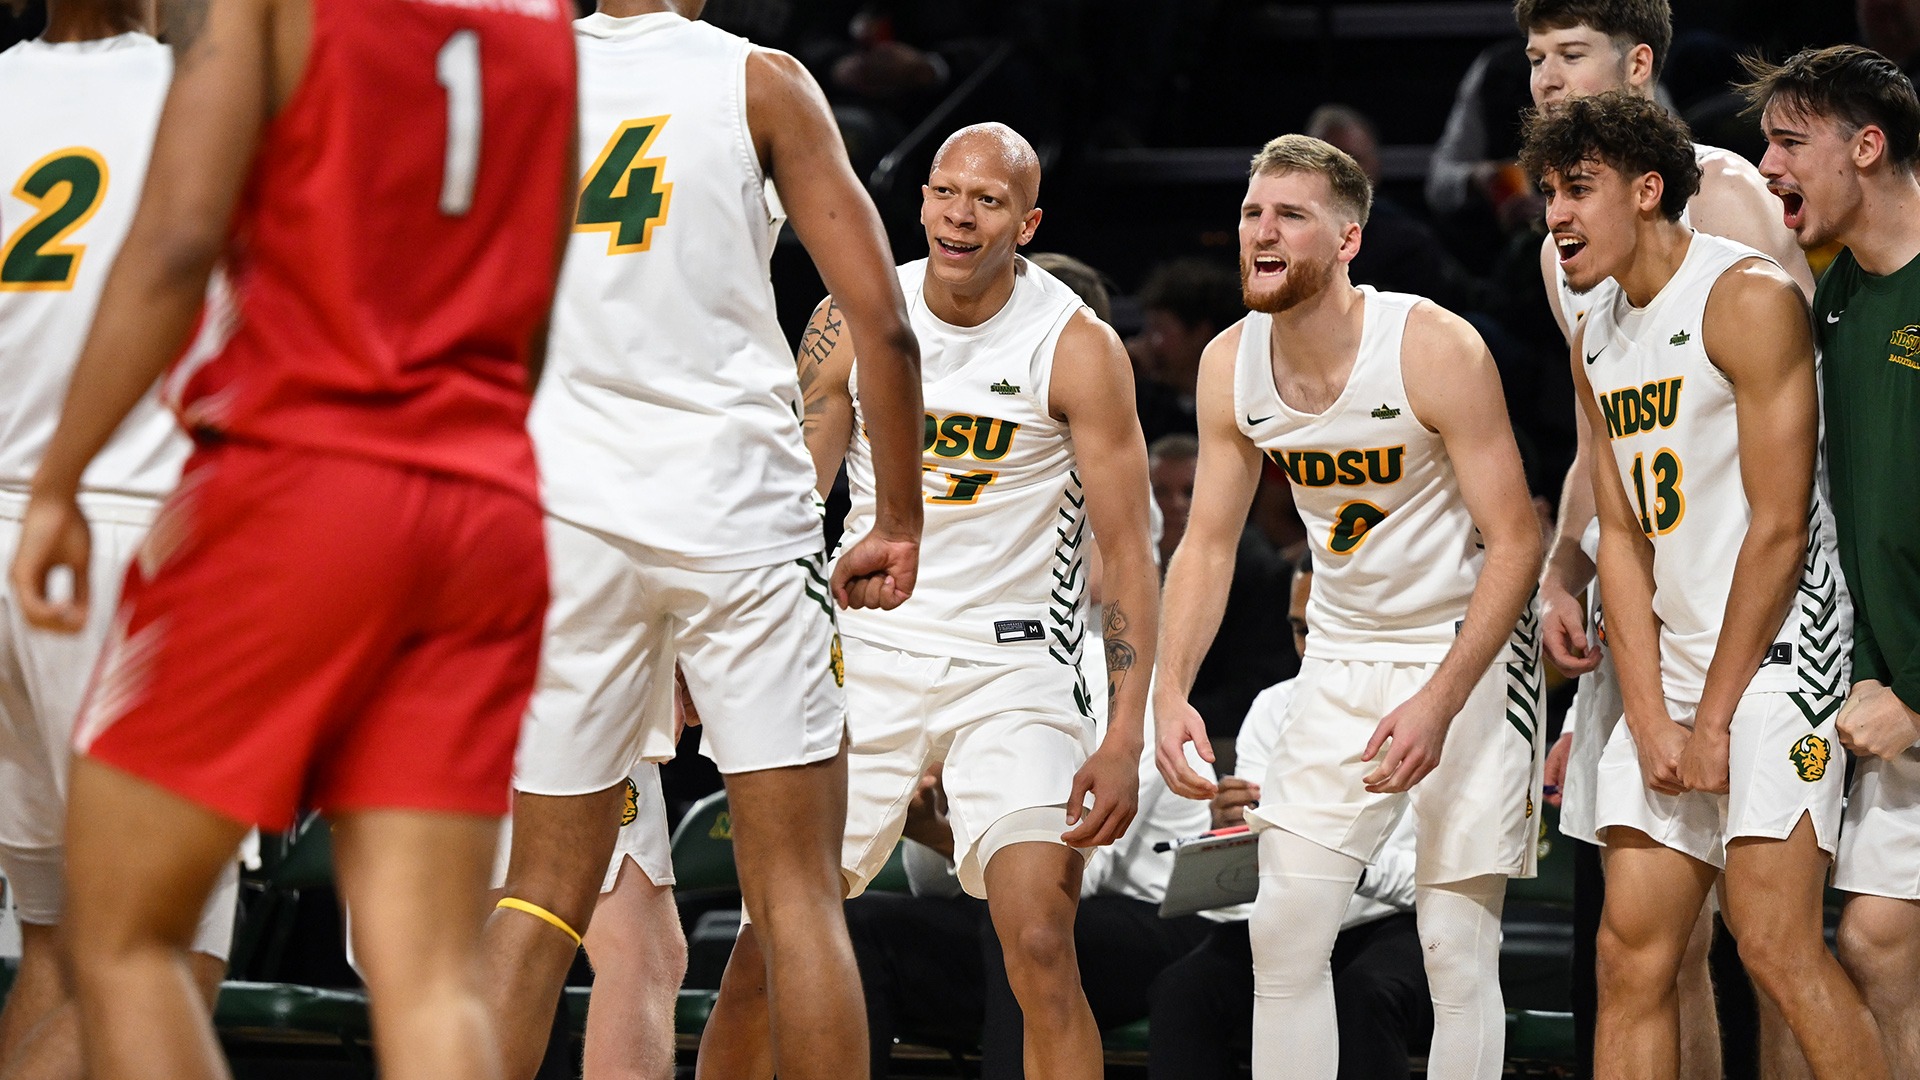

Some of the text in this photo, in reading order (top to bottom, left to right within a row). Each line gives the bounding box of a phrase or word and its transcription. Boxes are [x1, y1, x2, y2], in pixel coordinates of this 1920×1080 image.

[434, 28, 484, 218] 1
[571, 114, 674, 256] 4
[0, 145, 110, 292] 2
[862, 411, 1021, 462] SU
[1599, 376, 1684, 442] NDSU
[922, 462, 999, 505] 1
[1269, 443, 1406, 488] NDSU
[1630, 447, 1686, 538] 13
[1028, 625, 1039, 634] M
[1776, 648, 1785, 658] L
